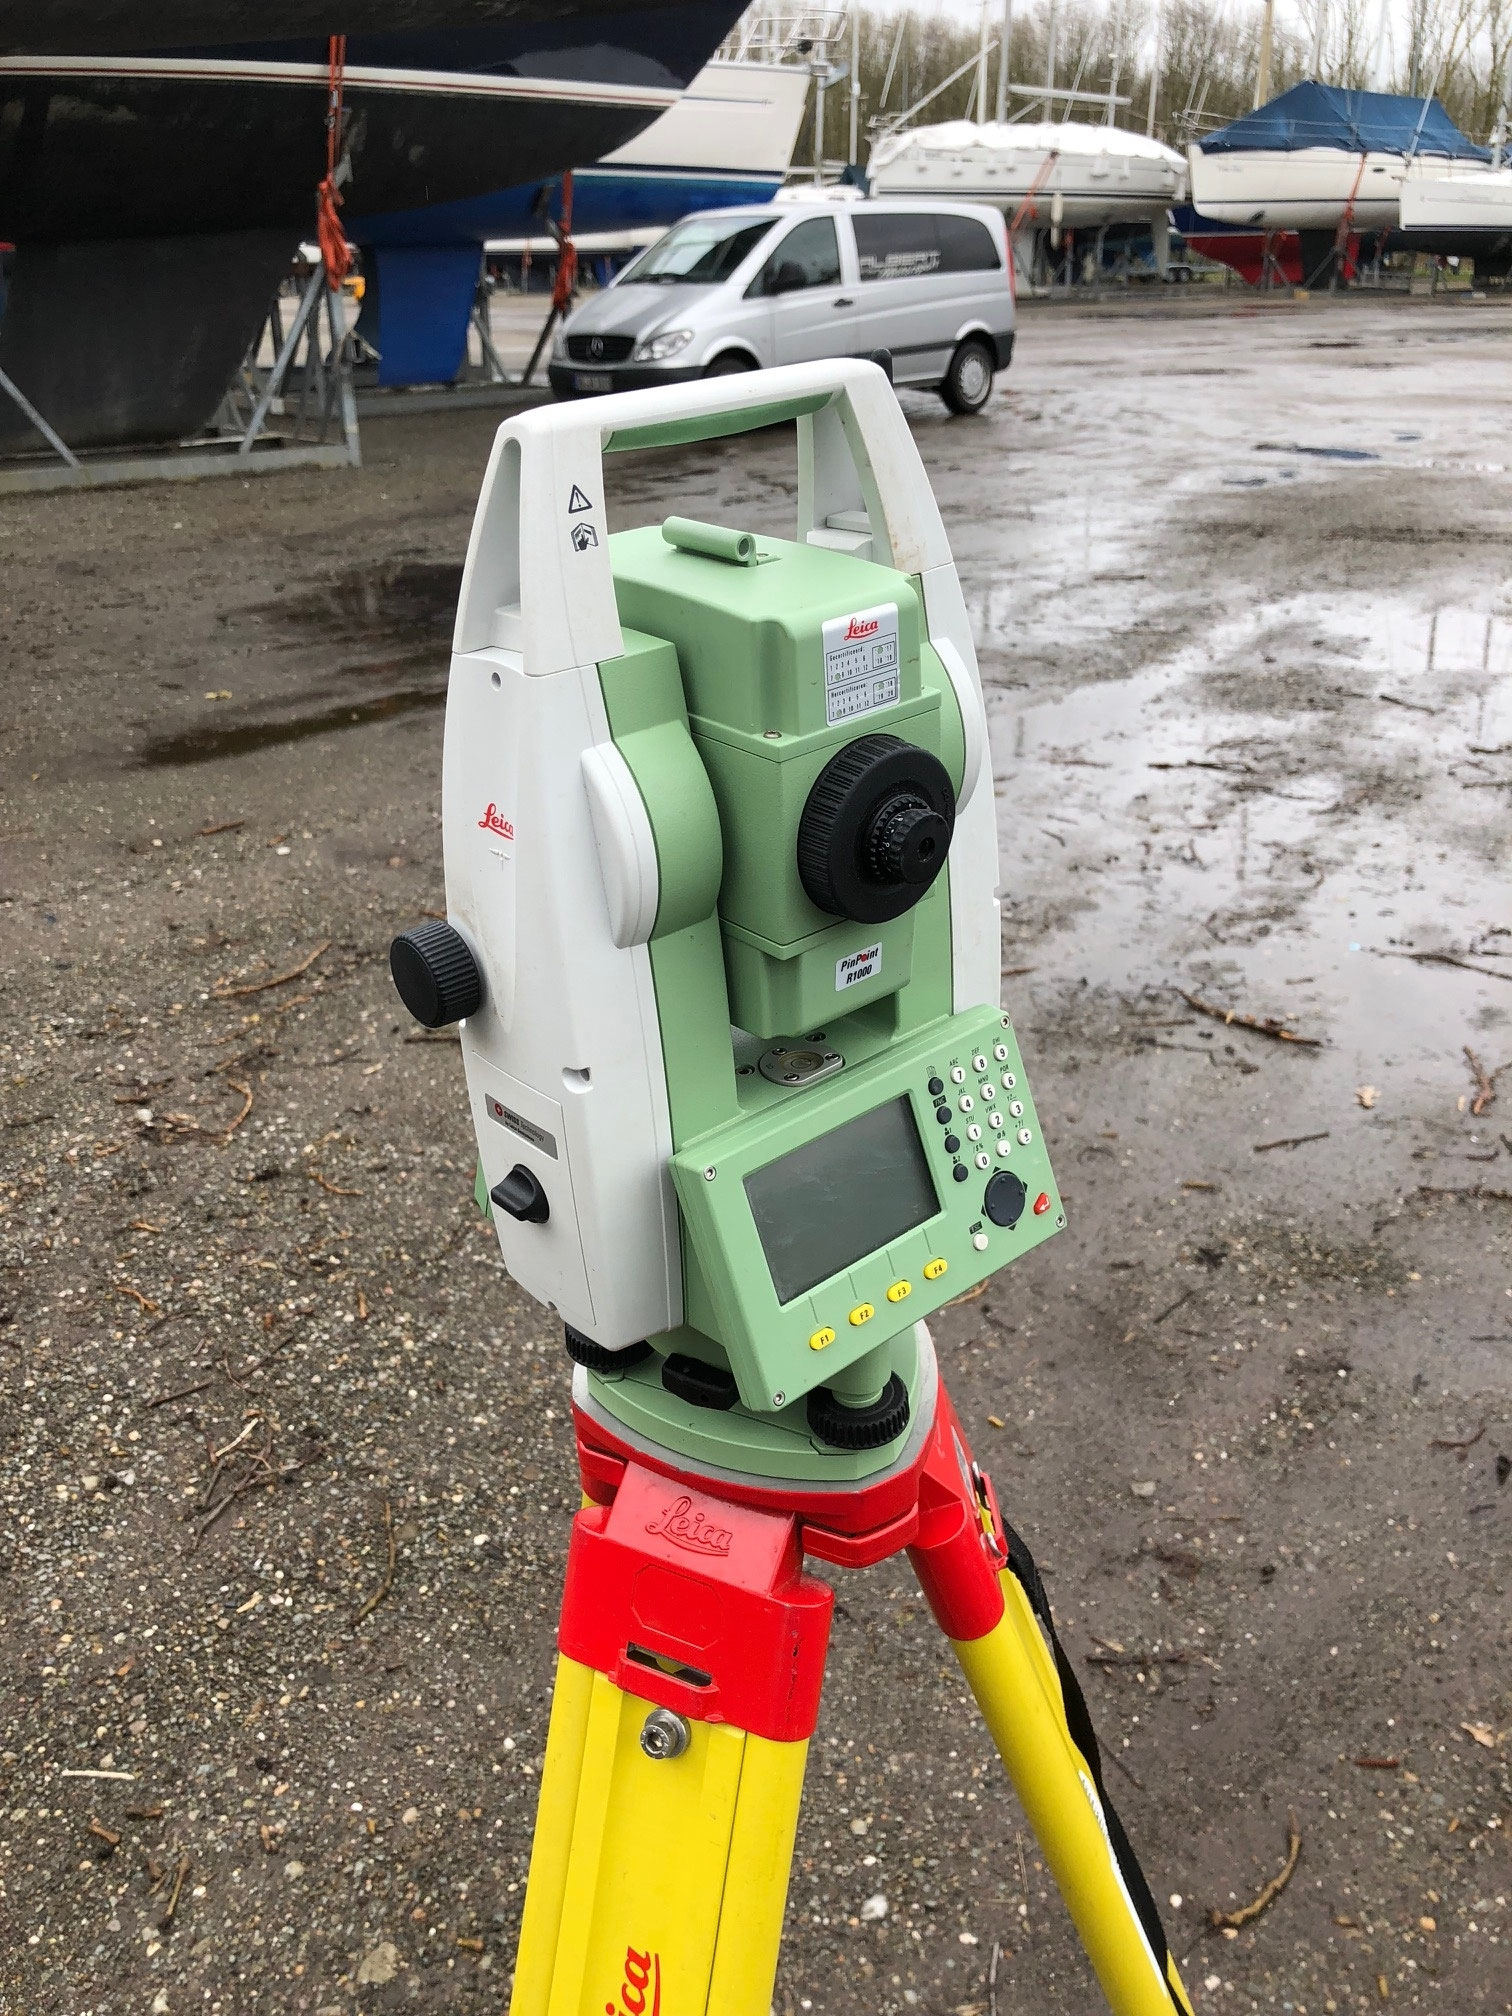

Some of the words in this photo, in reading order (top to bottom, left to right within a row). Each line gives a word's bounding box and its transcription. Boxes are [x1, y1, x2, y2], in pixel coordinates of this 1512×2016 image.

[843, 618, 879, 640] Leica
[478, 802, 514, 840] Leica
[841, 947, 878, 972] PinPoint
[846, 964, 873, 984] R1000
[999, 1048, 1006, 1058] 9
[949, 1057, 959, 1067] ABC
[979, 1058, 985, 1069] 8
[957, 1070, 962, 1080] 7
[1008, 1076, 1014, 1086] 6
[957, 1087, 966, 1096] JKL
[987, 1087, 993, 1097] 5
[965, 1099, 971, 1108] 4
[1015, 1104, 1021, 1114] 3
[965, 1115, 975, 1124] STU
[995, 1115, 1001, 1125] 2
[973, 1128, 978, 1137] 1
[981, 1156, 987, 1166] 0
[933, 1264, 943, 1275] F4
[897, 1286, 907, 1297] F3
[860, 1309, 870, 1321] F2
[820, 1334, 830, 1346] F1
[645, 1495, 733, 1557] Leica
